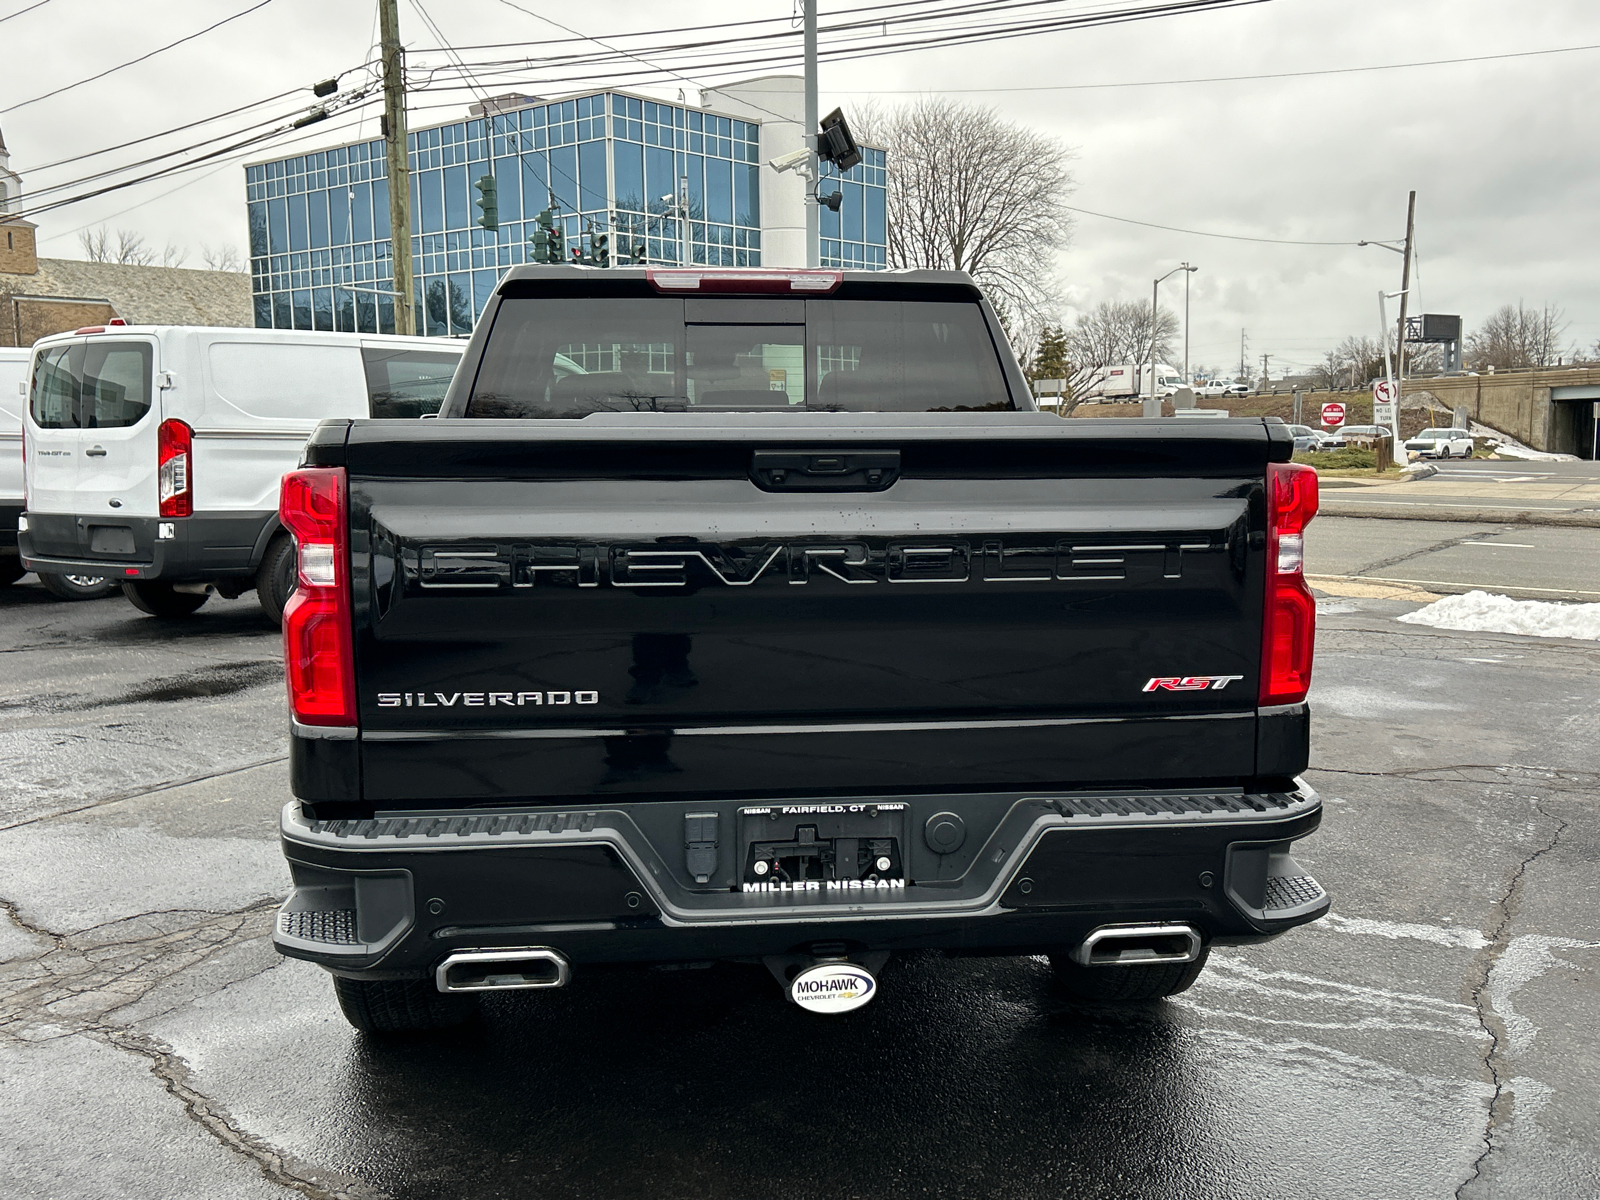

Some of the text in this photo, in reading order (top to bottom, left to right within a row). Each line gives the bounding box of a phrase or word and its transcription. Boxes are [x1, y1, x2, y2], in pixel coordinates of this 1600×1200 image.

[418, 536, 1212, 588] CHEVROLET
[1142, 675, 1244, 692] RST
[377, 690, 599, 707] SILVERADO
[782, 804, 866, 814] FAIRFIELD, CT
[877, 803, 904, 811] NISSAN
[743, 878, 905, 893] MILLER NISSAN
[797, 978, 859, 994] MOHAWK
[797, 994, 836, 1002] CHEVROLET
